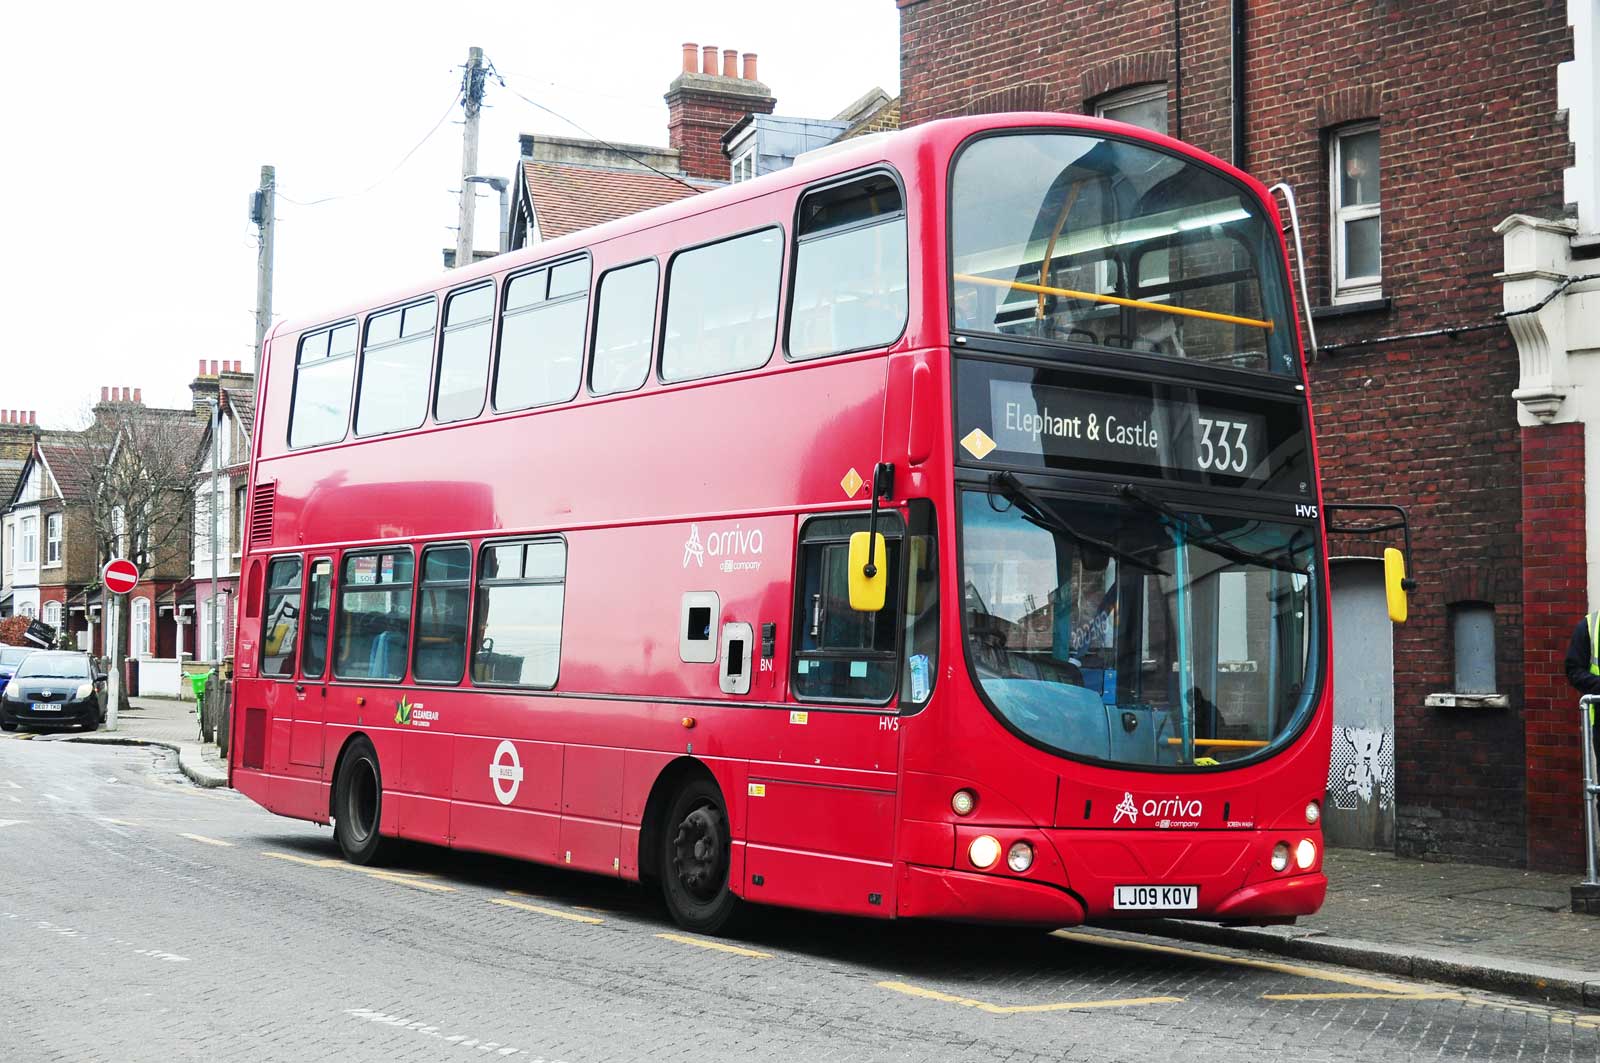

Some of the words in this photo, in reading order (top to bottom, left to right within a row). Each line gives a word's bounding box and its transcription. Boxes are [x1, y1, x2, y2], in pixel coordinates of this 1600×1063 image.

[1005, 402, 1081, 441] Elephant
[1087, 413, 1100, 441] &
[1105, 416, 1158, 448] Castle
[1197, 418, 1248, 472] 333
[1295, 504, 1318, 518] HV5
[707, 523, 763, 556] arriva
[734, 561, 760, 571] company
[760, 659, 772, 671] BN
[879, 716, 899, 731] HV5
[1142, 795, 1203, 817] arriva
[1169, 820, 1200, 829] company
[1118, 888, 1158, 906] LJ09
[1162, 888, 1191, 905] KOV
